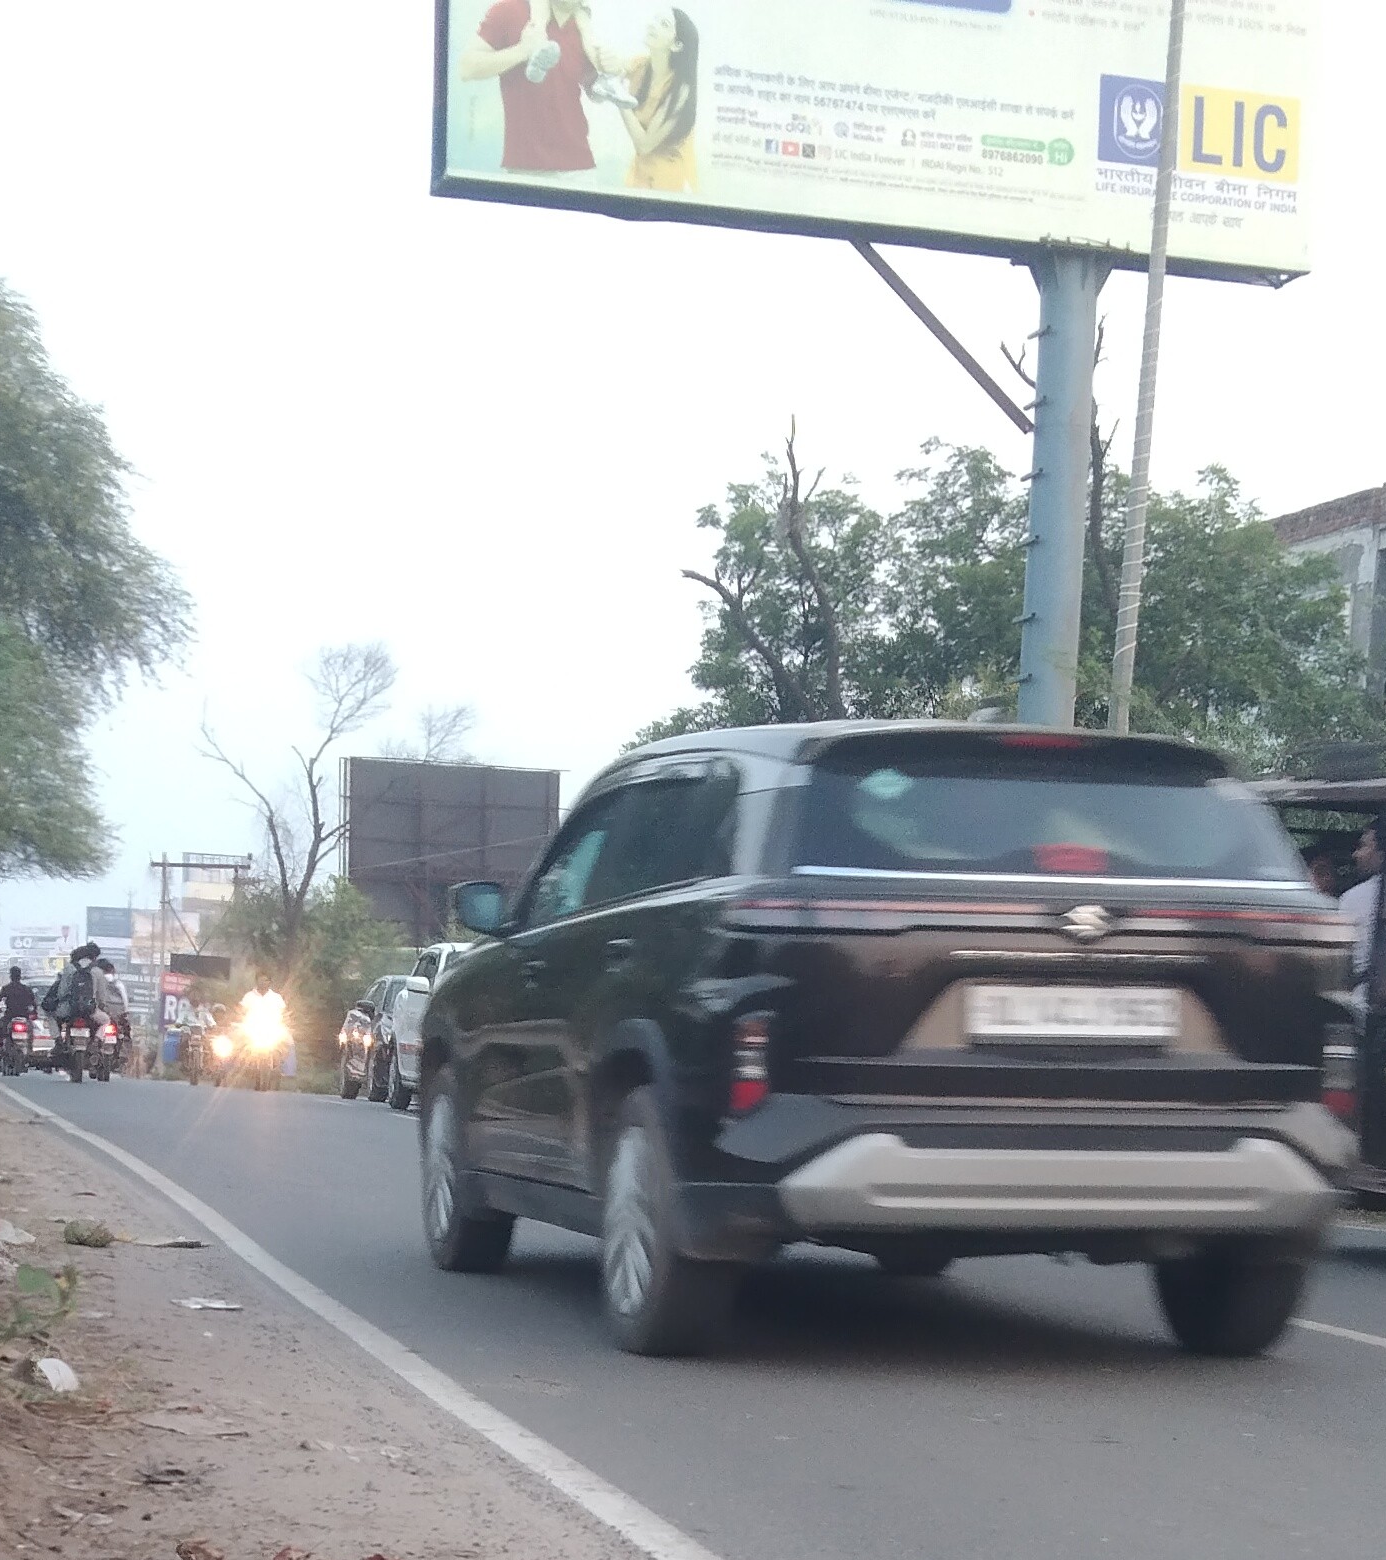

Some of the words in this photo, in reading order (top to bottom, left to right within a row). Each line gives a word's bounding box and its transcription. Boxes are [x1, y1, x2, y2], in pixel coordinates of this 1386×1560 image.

[1192, 96, 1288, 174] LIC
[982, 148, 1044, 165] 8976862090
[1095, 182, 1116, 193] LIFE
[1181, 192, 1251, 209] CORPORATION
[1254, 200, 1266, 210] OF
[1270, 203, 1297, 214] INDIA
[1096, 167, 1153, 184] भारतीय
[1215, 179, 1248, 196] बीमा
[1258, 183, 1297, 202] निगम
